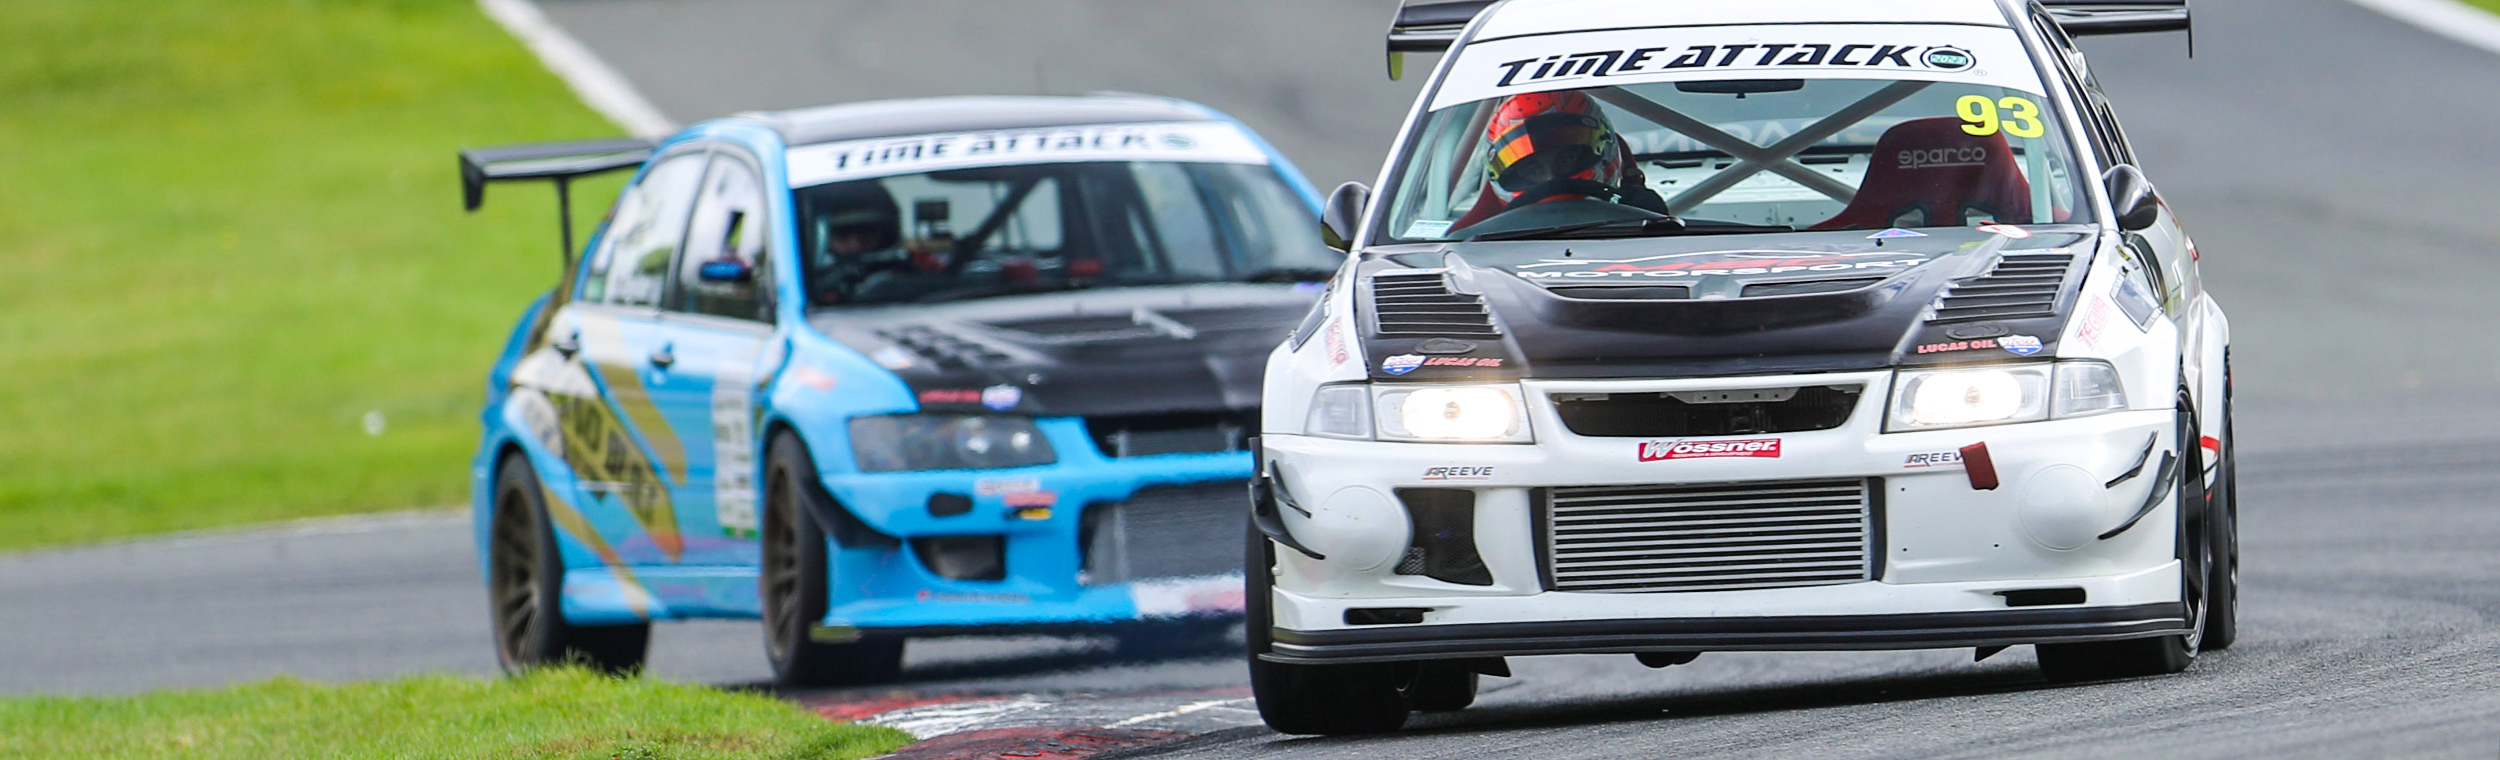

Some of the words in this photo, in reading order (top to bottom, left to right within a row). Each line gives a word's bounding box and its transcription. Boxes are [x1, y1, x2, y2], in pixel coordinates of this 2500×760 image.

[1956, 95, 2045, 138] 93
[1898, 147, 1986, 169] sparco
[1516, 258, 1930, 279] MOTORSPORT
[1918, 341, 1968, 353] LUCAS
[1970, 340, 1997, 349] OIL
[1423, 357, 1477, 367] LUCAS
[1475, 358, 1503, 367] OIL
[1905, 452, 1964, 467] AREEV
